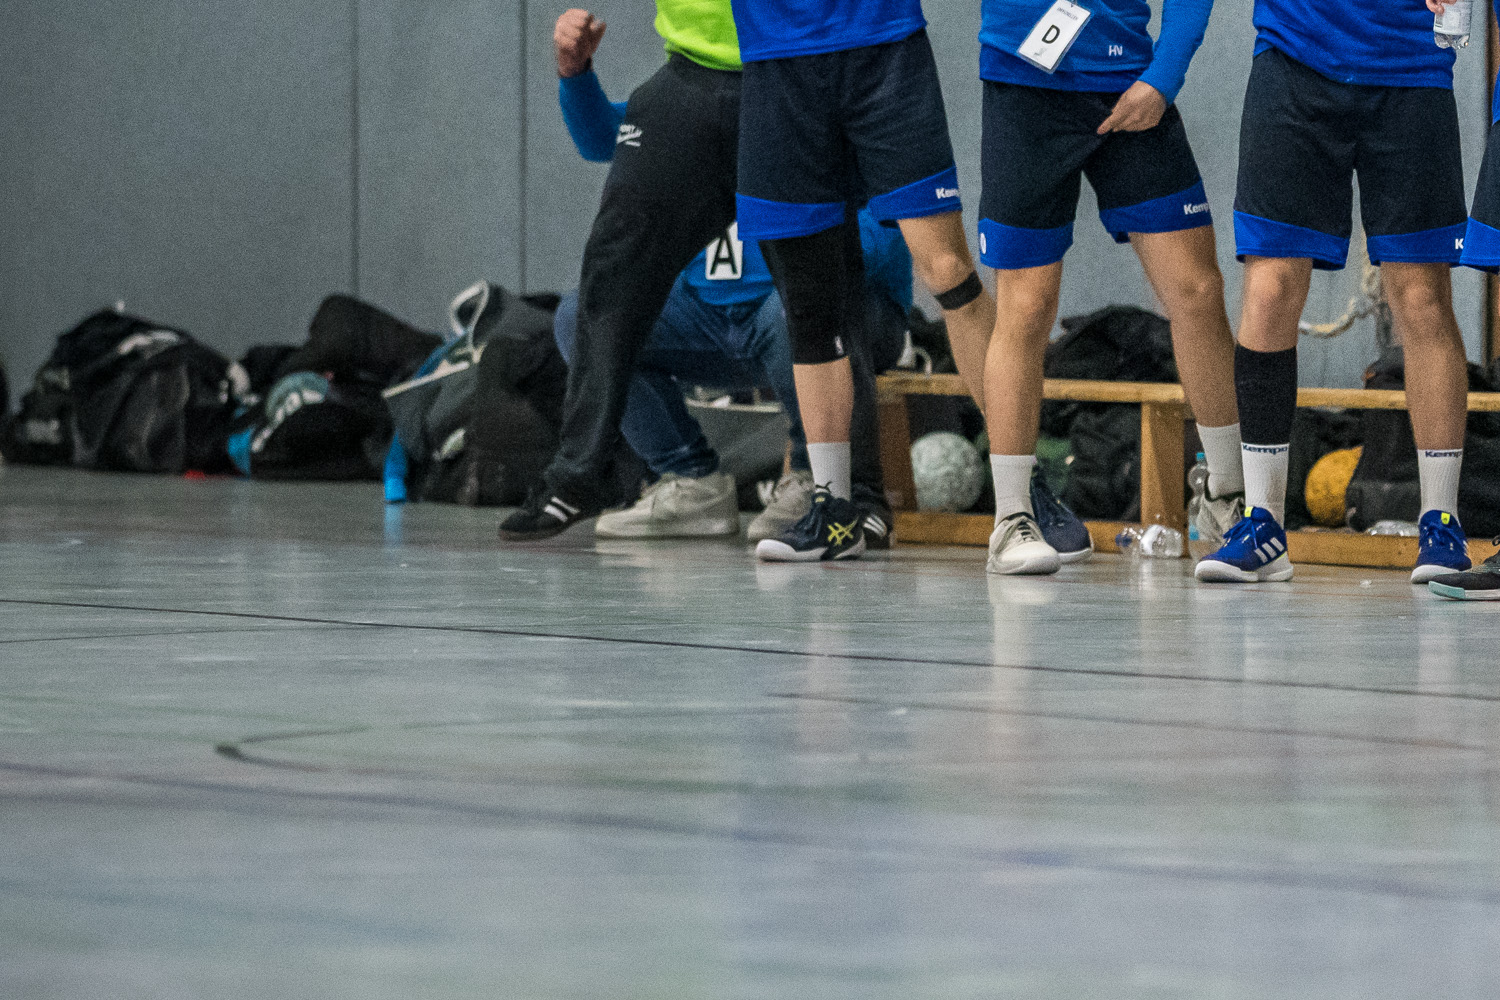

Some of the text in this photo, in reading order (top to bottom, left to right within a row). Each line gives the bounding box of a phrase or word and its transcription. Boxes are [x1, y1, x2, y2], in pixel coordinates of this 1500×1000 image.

[1041, 24, 1060, 44] D
[1108, 44, 1123, 56] HN
[710, 229, 738, 275] A
[1242, 444, 1288, 455] Kempa
